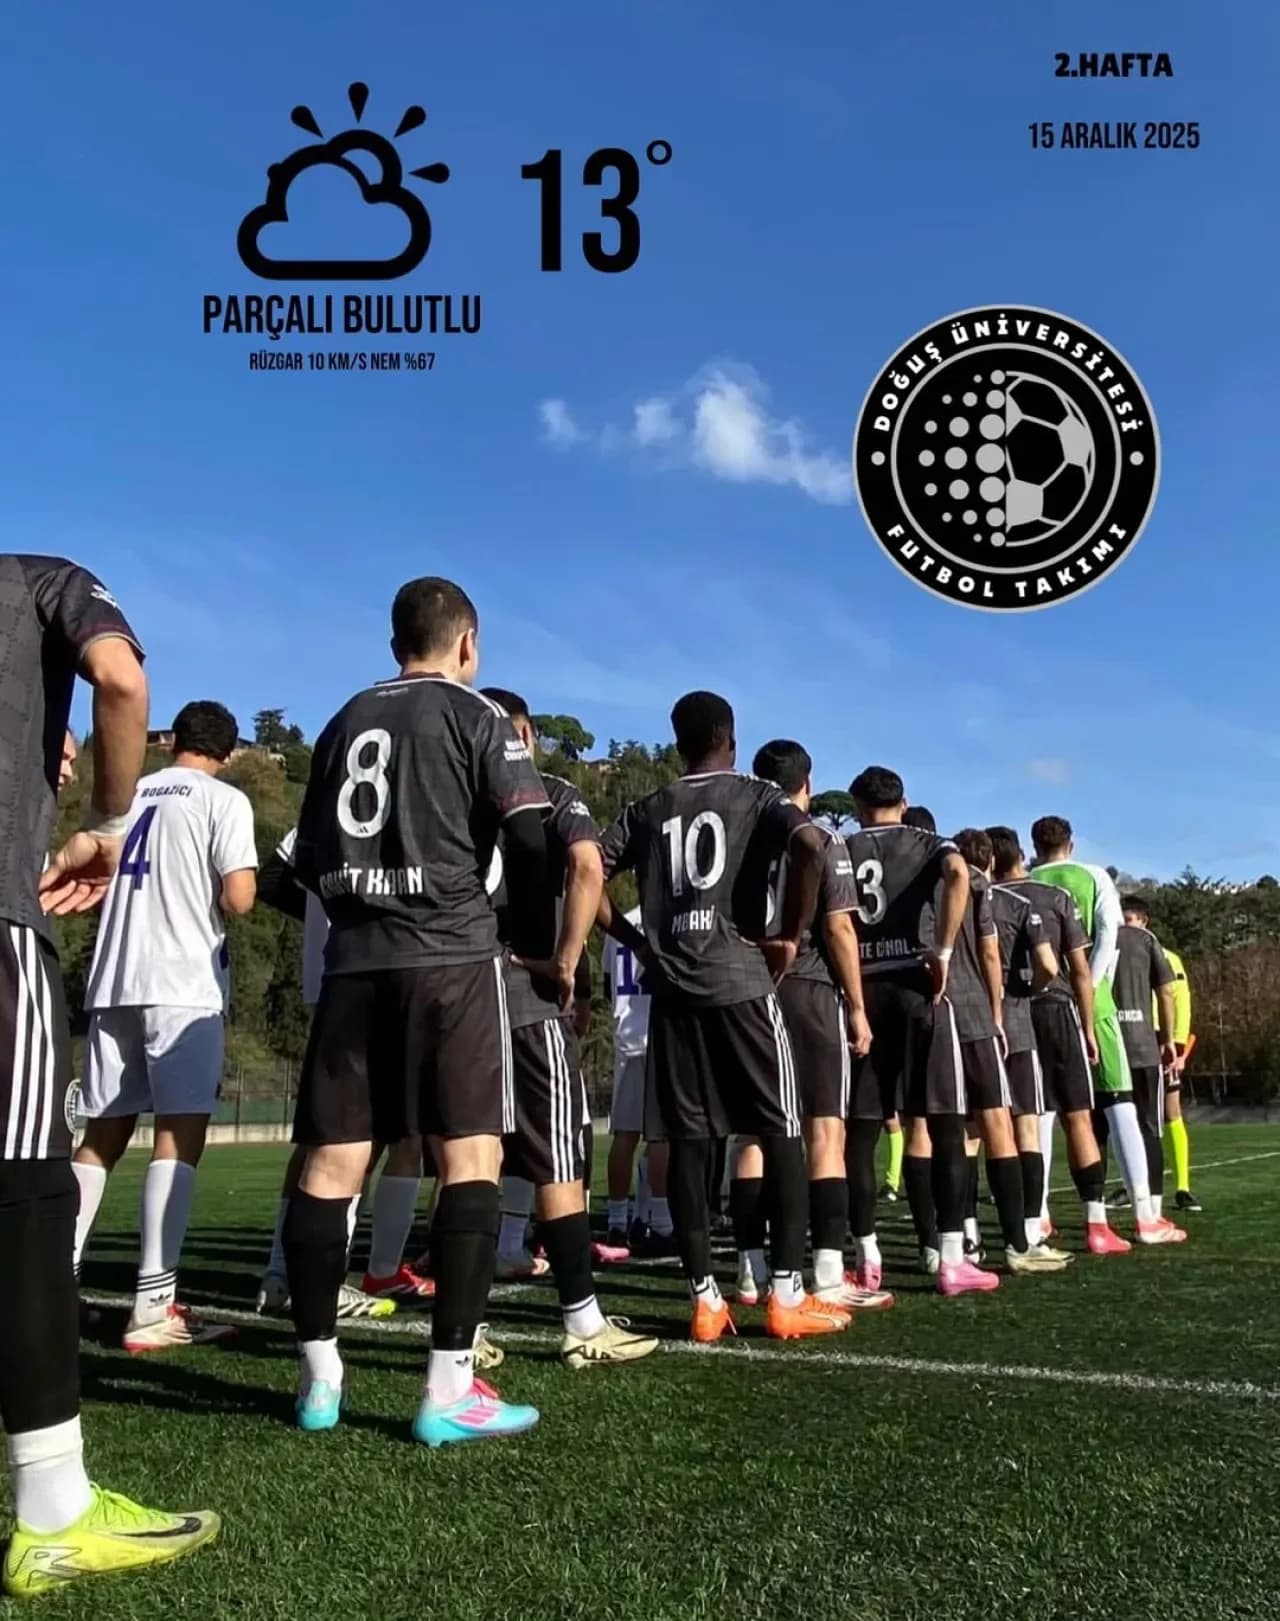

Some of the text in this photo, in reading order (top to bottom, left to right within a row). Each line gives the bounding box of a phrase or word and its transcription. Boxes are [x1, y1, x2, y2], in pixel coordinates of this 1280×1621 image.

[337, 728, 391, 838] 8
[119, 804, 158, 890] 4
[662, 810, 727, 896] 10
